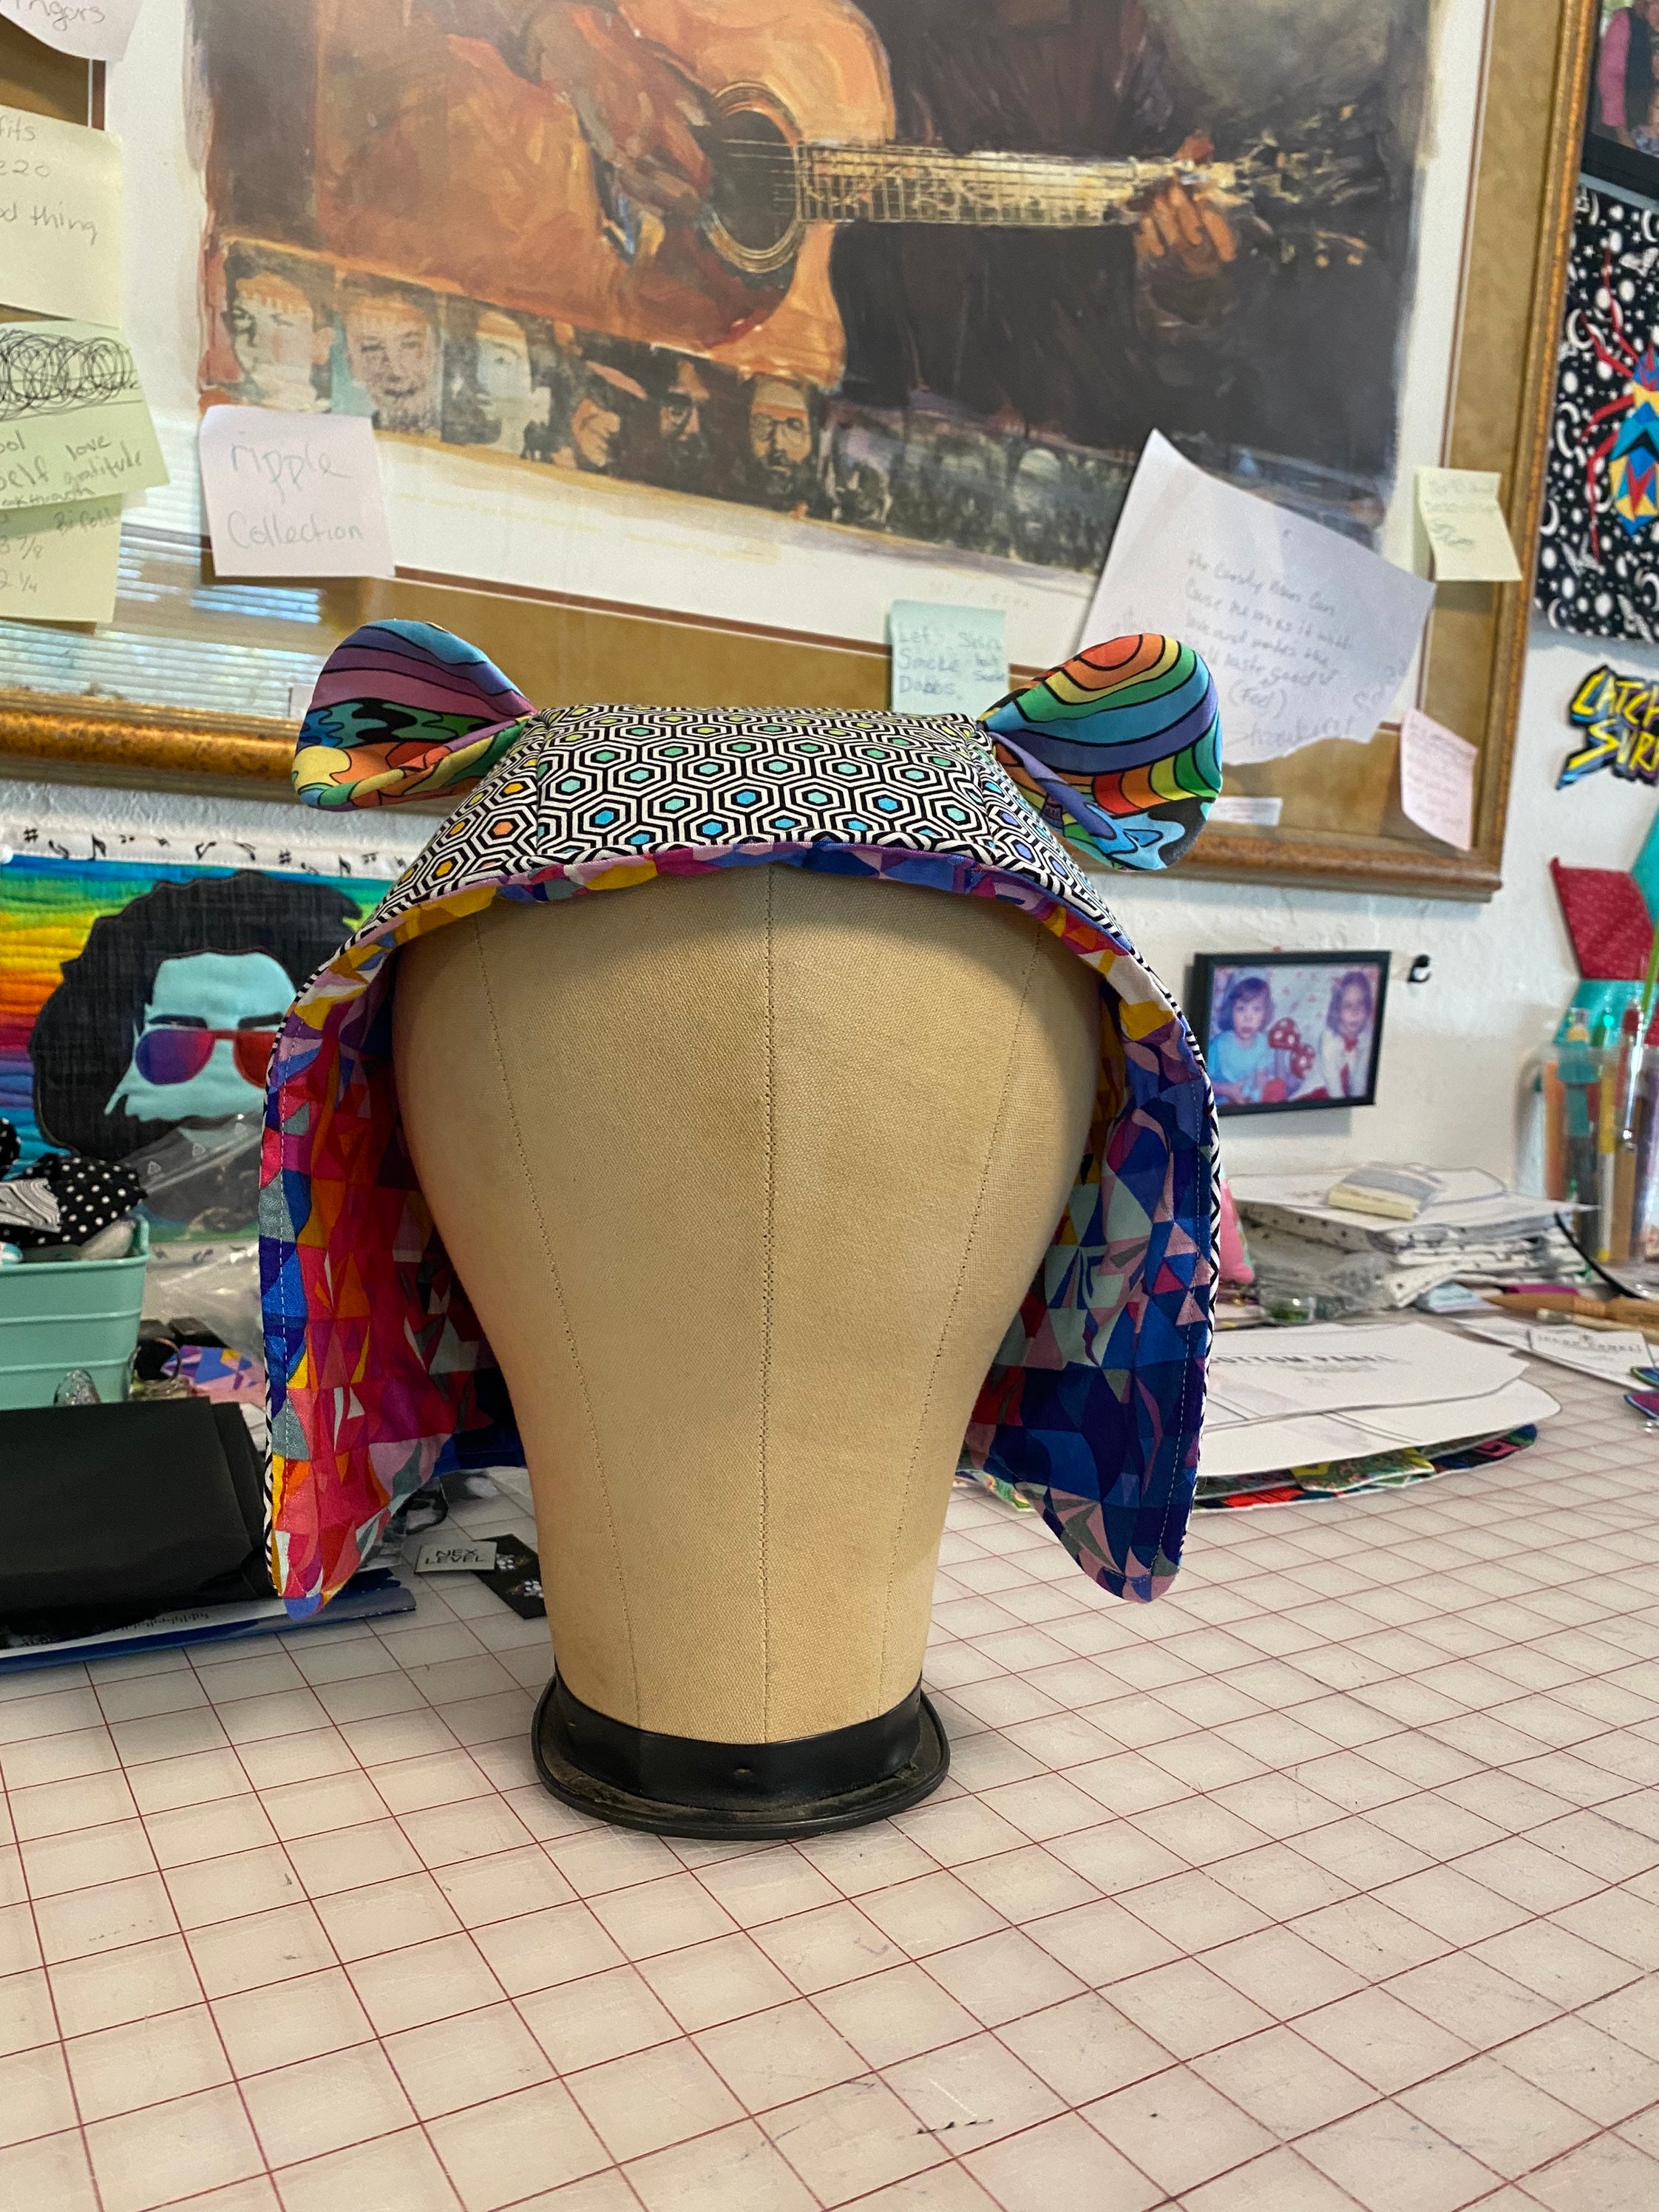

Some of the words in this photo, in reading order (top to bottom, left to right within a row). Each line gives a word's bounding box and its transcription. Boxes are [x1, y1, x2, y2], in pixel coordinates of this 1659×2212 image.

[30, 201, 98, 245] thing
[65, 435, 112, 461] love
[227, 509, 364, 549] Collection
